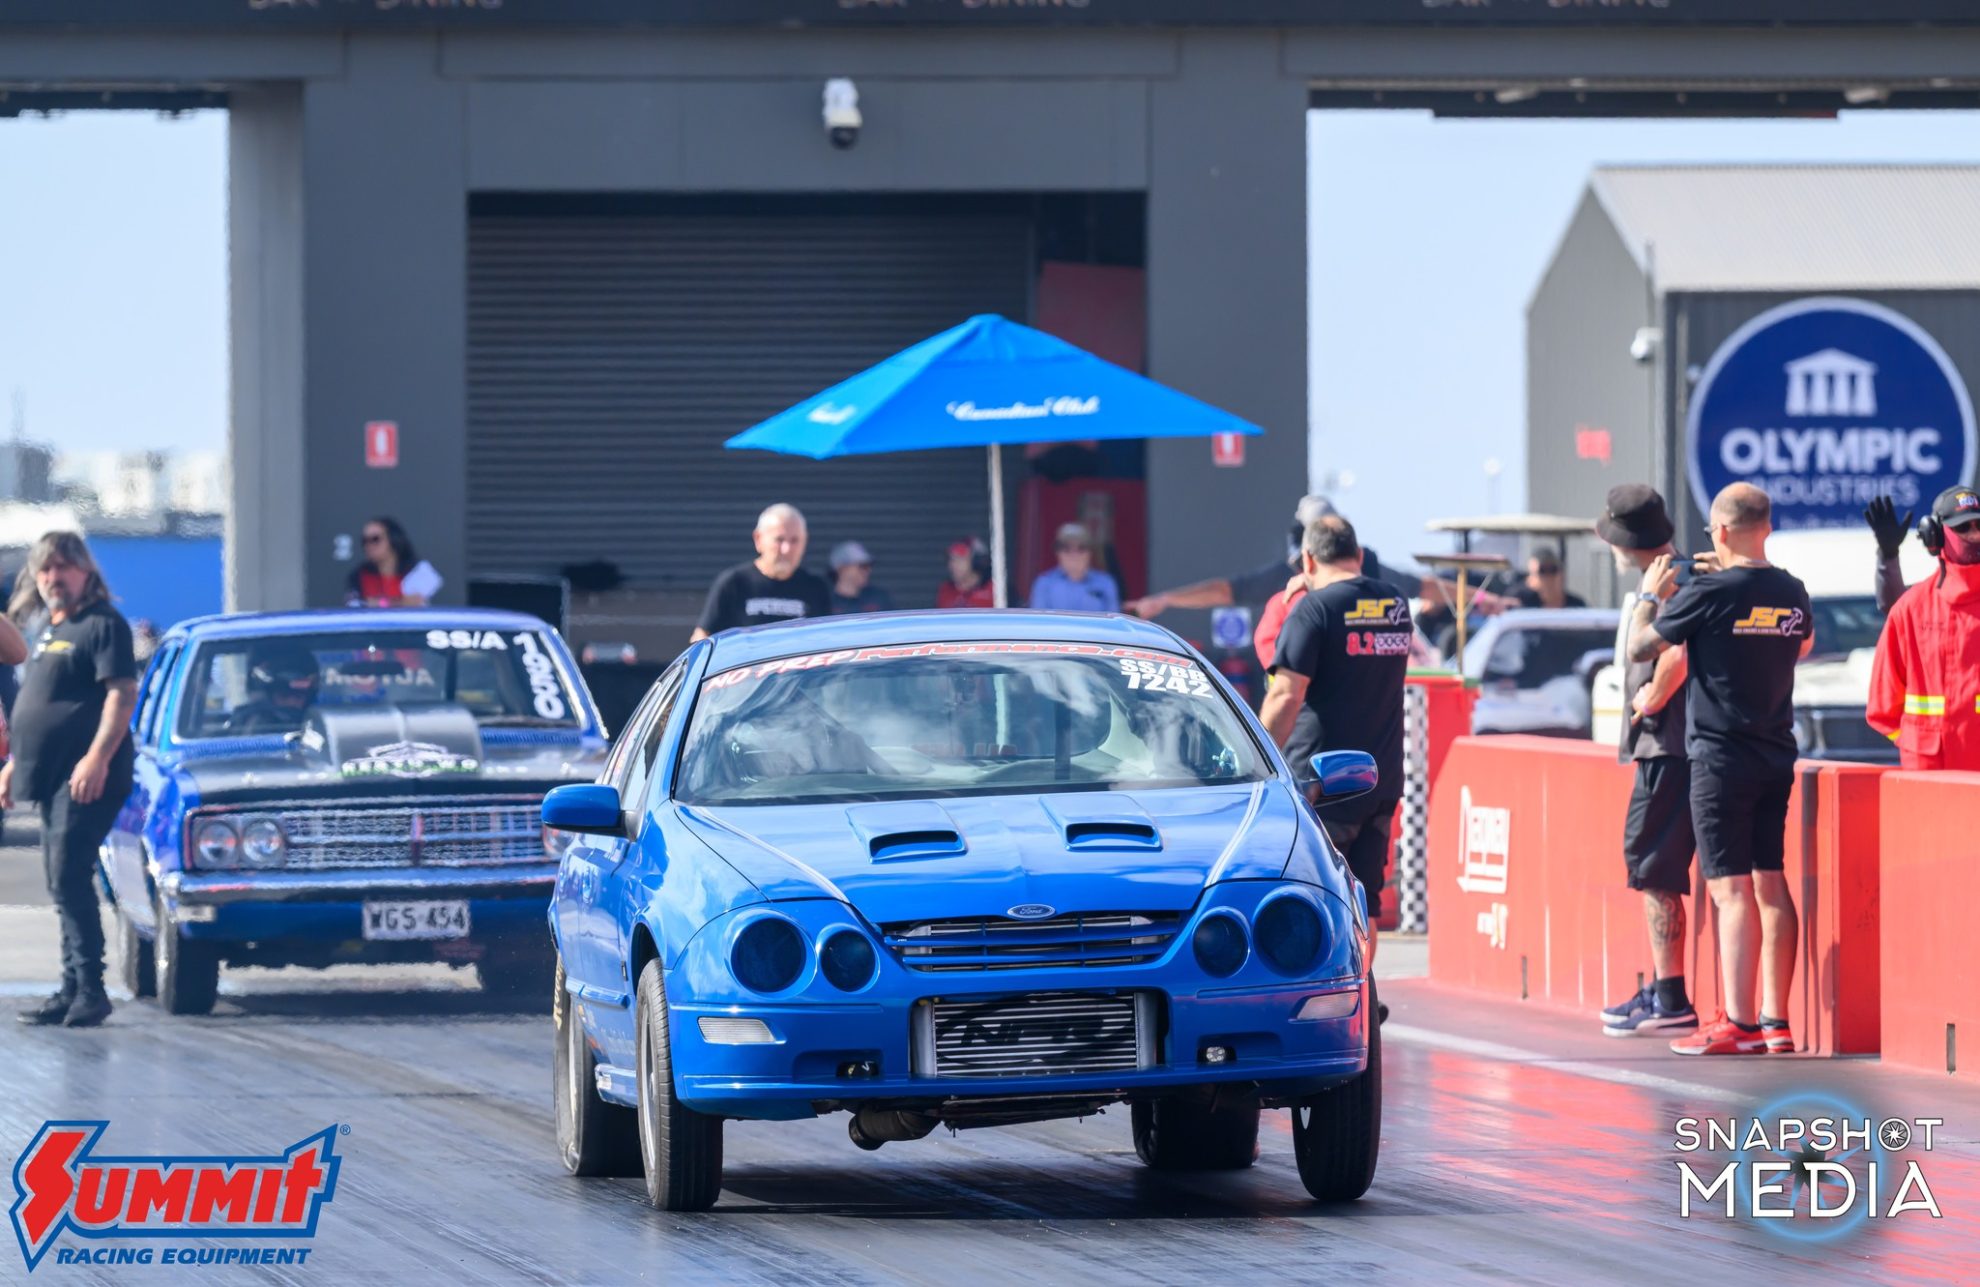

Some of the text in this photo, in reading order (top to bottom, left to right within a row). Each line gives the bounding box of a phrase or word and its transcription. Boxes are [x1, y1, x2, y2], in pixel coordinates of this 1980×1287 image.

[1719, 427, 1942, 475] OLYMPIC
[1746, 474, 1920, 508] NDUSTRIES
[426, 630, 508, 650] SS/A
[704, 668, 751, 693] NO
[757, 650, 858, 679] PREP
[1119, 658, 1208, 682] SS/BB
[1120, 670, 1214, 698] 7242
